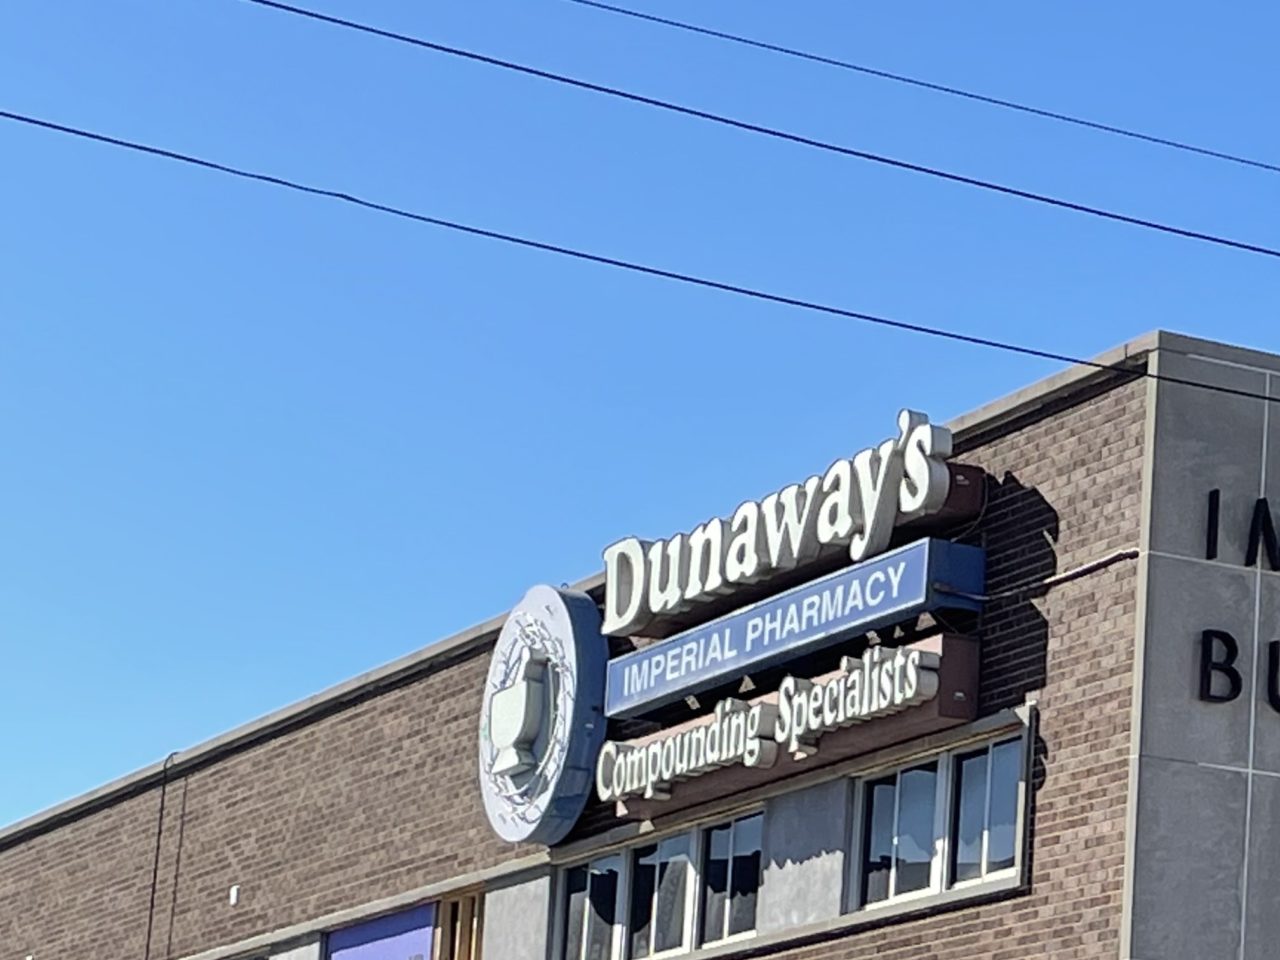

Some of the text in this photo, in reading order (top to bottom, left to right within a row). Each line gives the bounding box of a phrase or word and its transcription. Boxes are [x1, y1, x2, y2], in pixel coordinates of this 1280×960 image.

[602, 408, 940, 634] Dunaway's
[622, 561, 907, 697] IMPERIAL PHARMACY
[595, 646, 921, 803] Compounding Specialists
